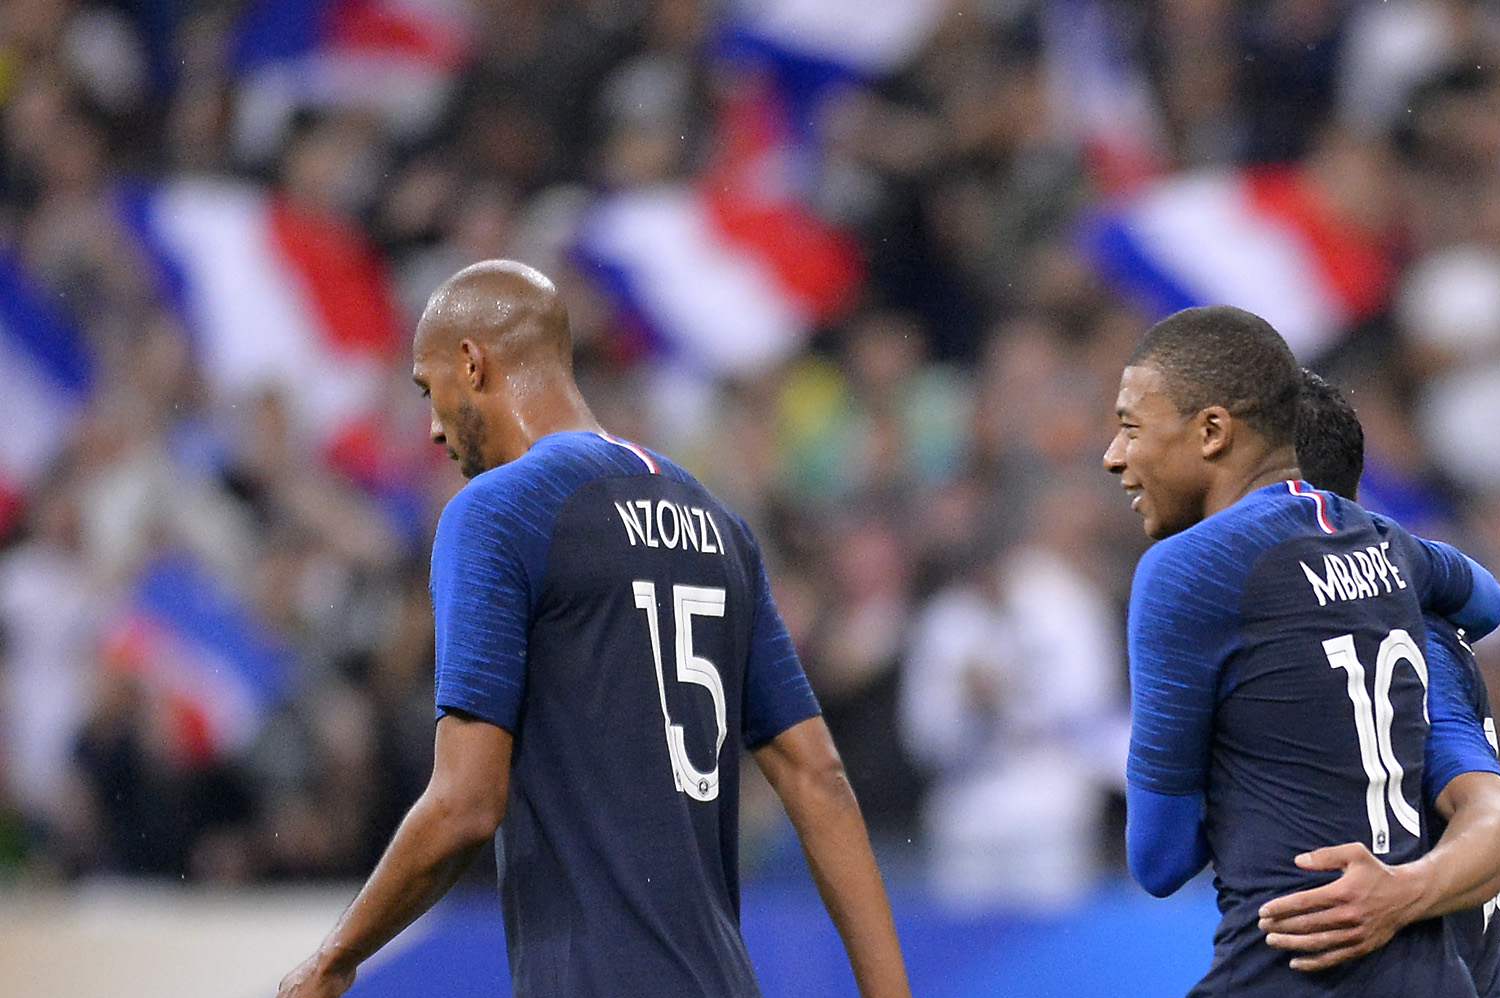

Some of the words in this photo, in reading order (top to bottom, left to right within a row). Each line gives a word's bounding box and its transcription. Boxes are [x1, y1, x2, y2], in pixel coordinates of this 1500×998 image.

[614, 500, 725, 556] NZONZI
[632, 581, 727, 802] 15
[1322, 629, 1430, 854] 10
